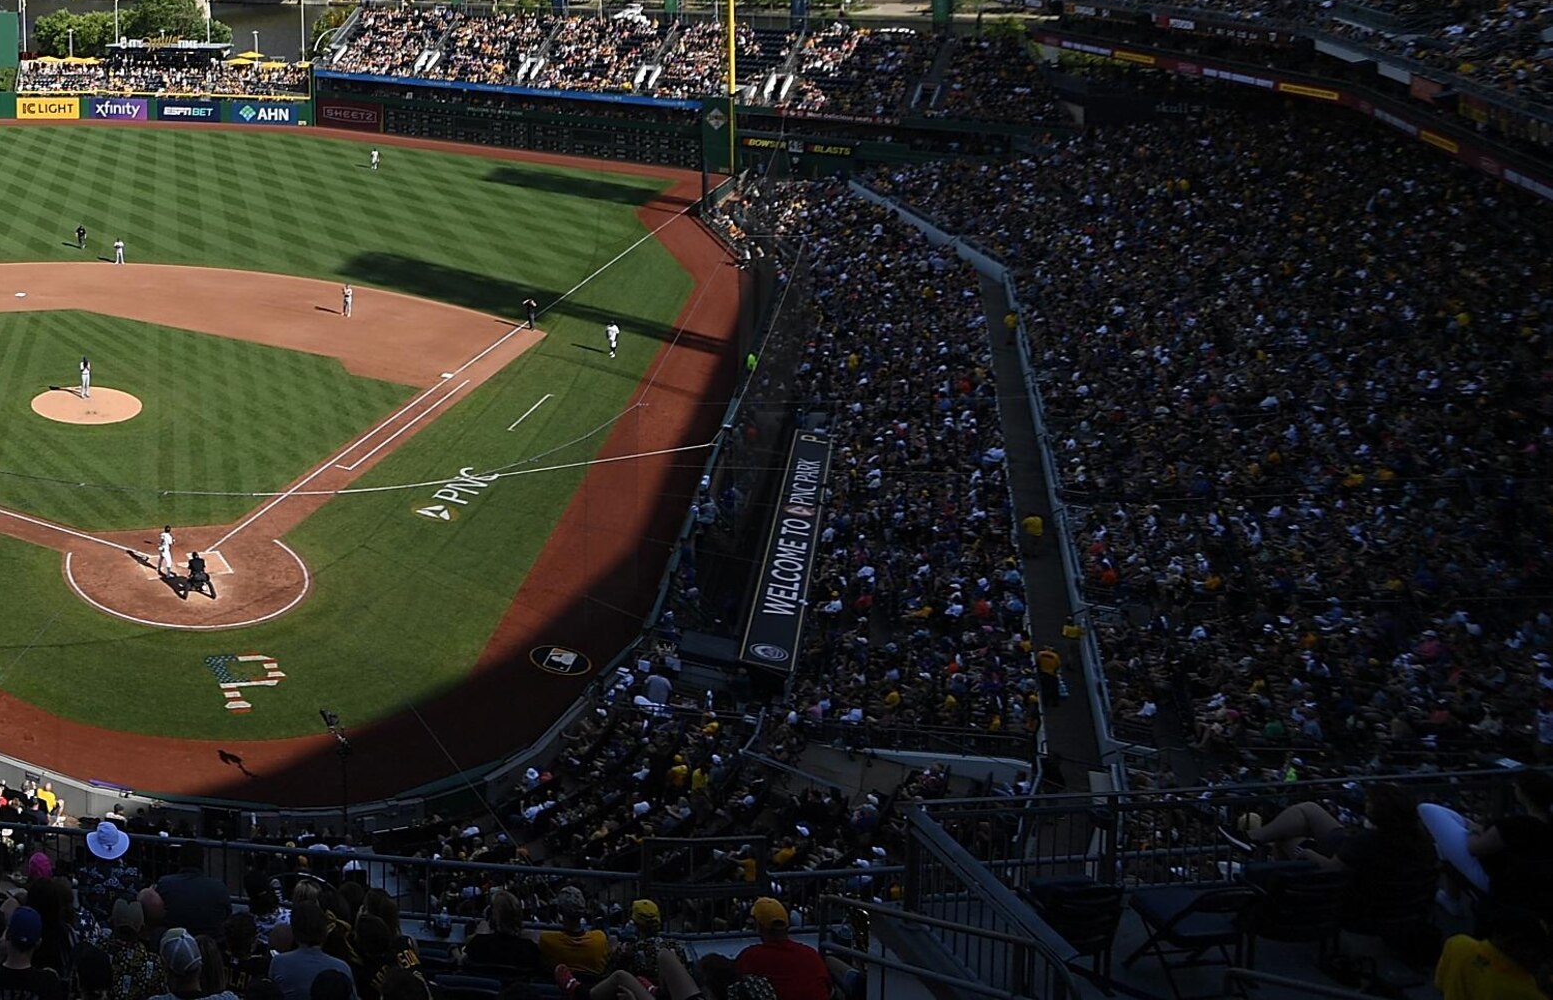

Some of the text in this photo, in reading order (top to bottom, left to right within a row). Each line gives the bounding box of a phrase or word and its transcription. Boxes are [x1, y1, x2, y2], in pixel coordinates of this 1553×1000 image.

[22, 103, 74, 114] IC LIGHT
[95, 103, 141, 118] xfinity
[192, 107, 214, 116] BET
[257, 108, 289, 121] AHN
[326, 108, 374, 120] SHEETZ
[813, 145, 851, 155] BLASTS
[797, 457, 822, 482] PARK
[432, 466, 499, 505] PNC
[789, 482, 817, 506] PNC
[781, 518, 811, 536] TO
[762, 537, 808, 616] WELCOME
